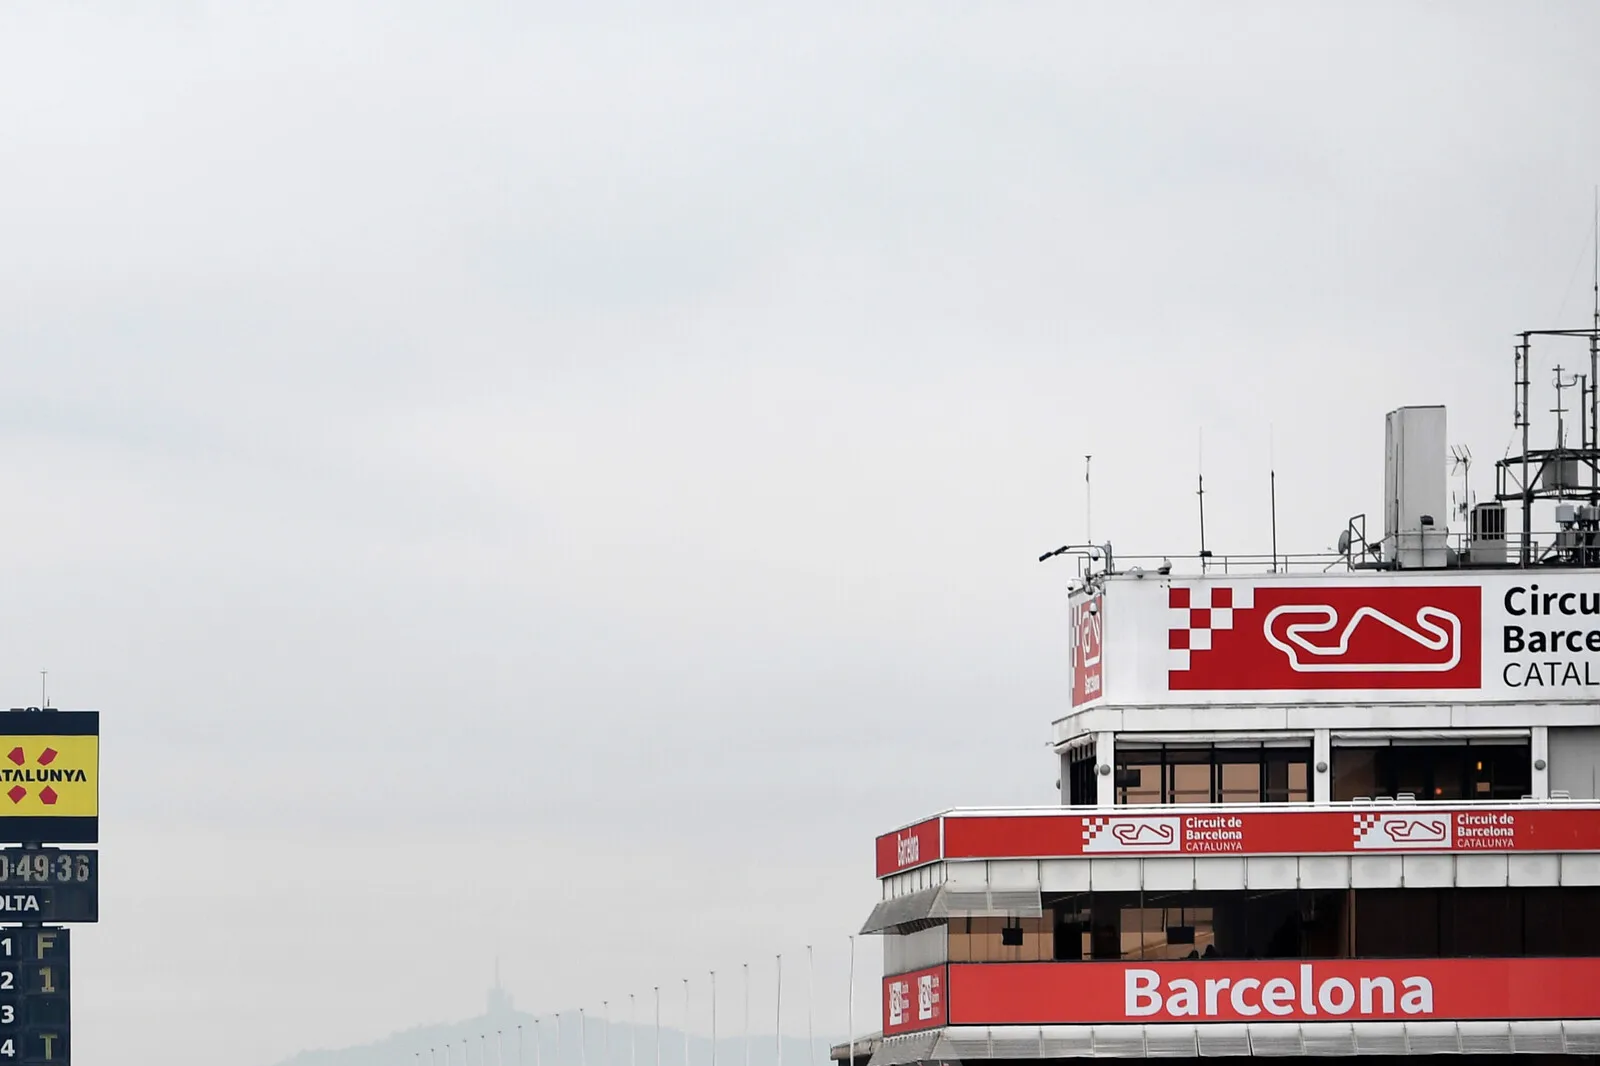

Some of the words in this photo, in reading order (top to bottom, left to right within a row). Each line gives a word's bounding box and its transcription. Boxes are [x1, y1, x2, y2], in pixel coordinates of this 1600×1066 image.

[1504, 584, 1600, 616] Circu
[1503, 625, 1600, 653] Barce
[1503, 661, 1600, 688] CATAL
[1186, 816, 1226, 828] Circuit
[1227, 816, 1243, 828] de
[1457, 813, 1497, 825] Circuit
[1499, 813, 1515, 825] de
[1186, 829, 1243, 840] Barcelona
[1457, 825, 1514, 837] Barcelona
[1185, 842, 1243, 851] CATALUNYA
[1457, 838, 1515, 848] CATALUNYA
[1, 938, 12, 956] 1
[0, 971, 14, 990] 2
[1124, 963, 1434, 1017] Barcelona
[1, 1004, 15, 1024] 3
[0, 1038, 16, 1057] 4
